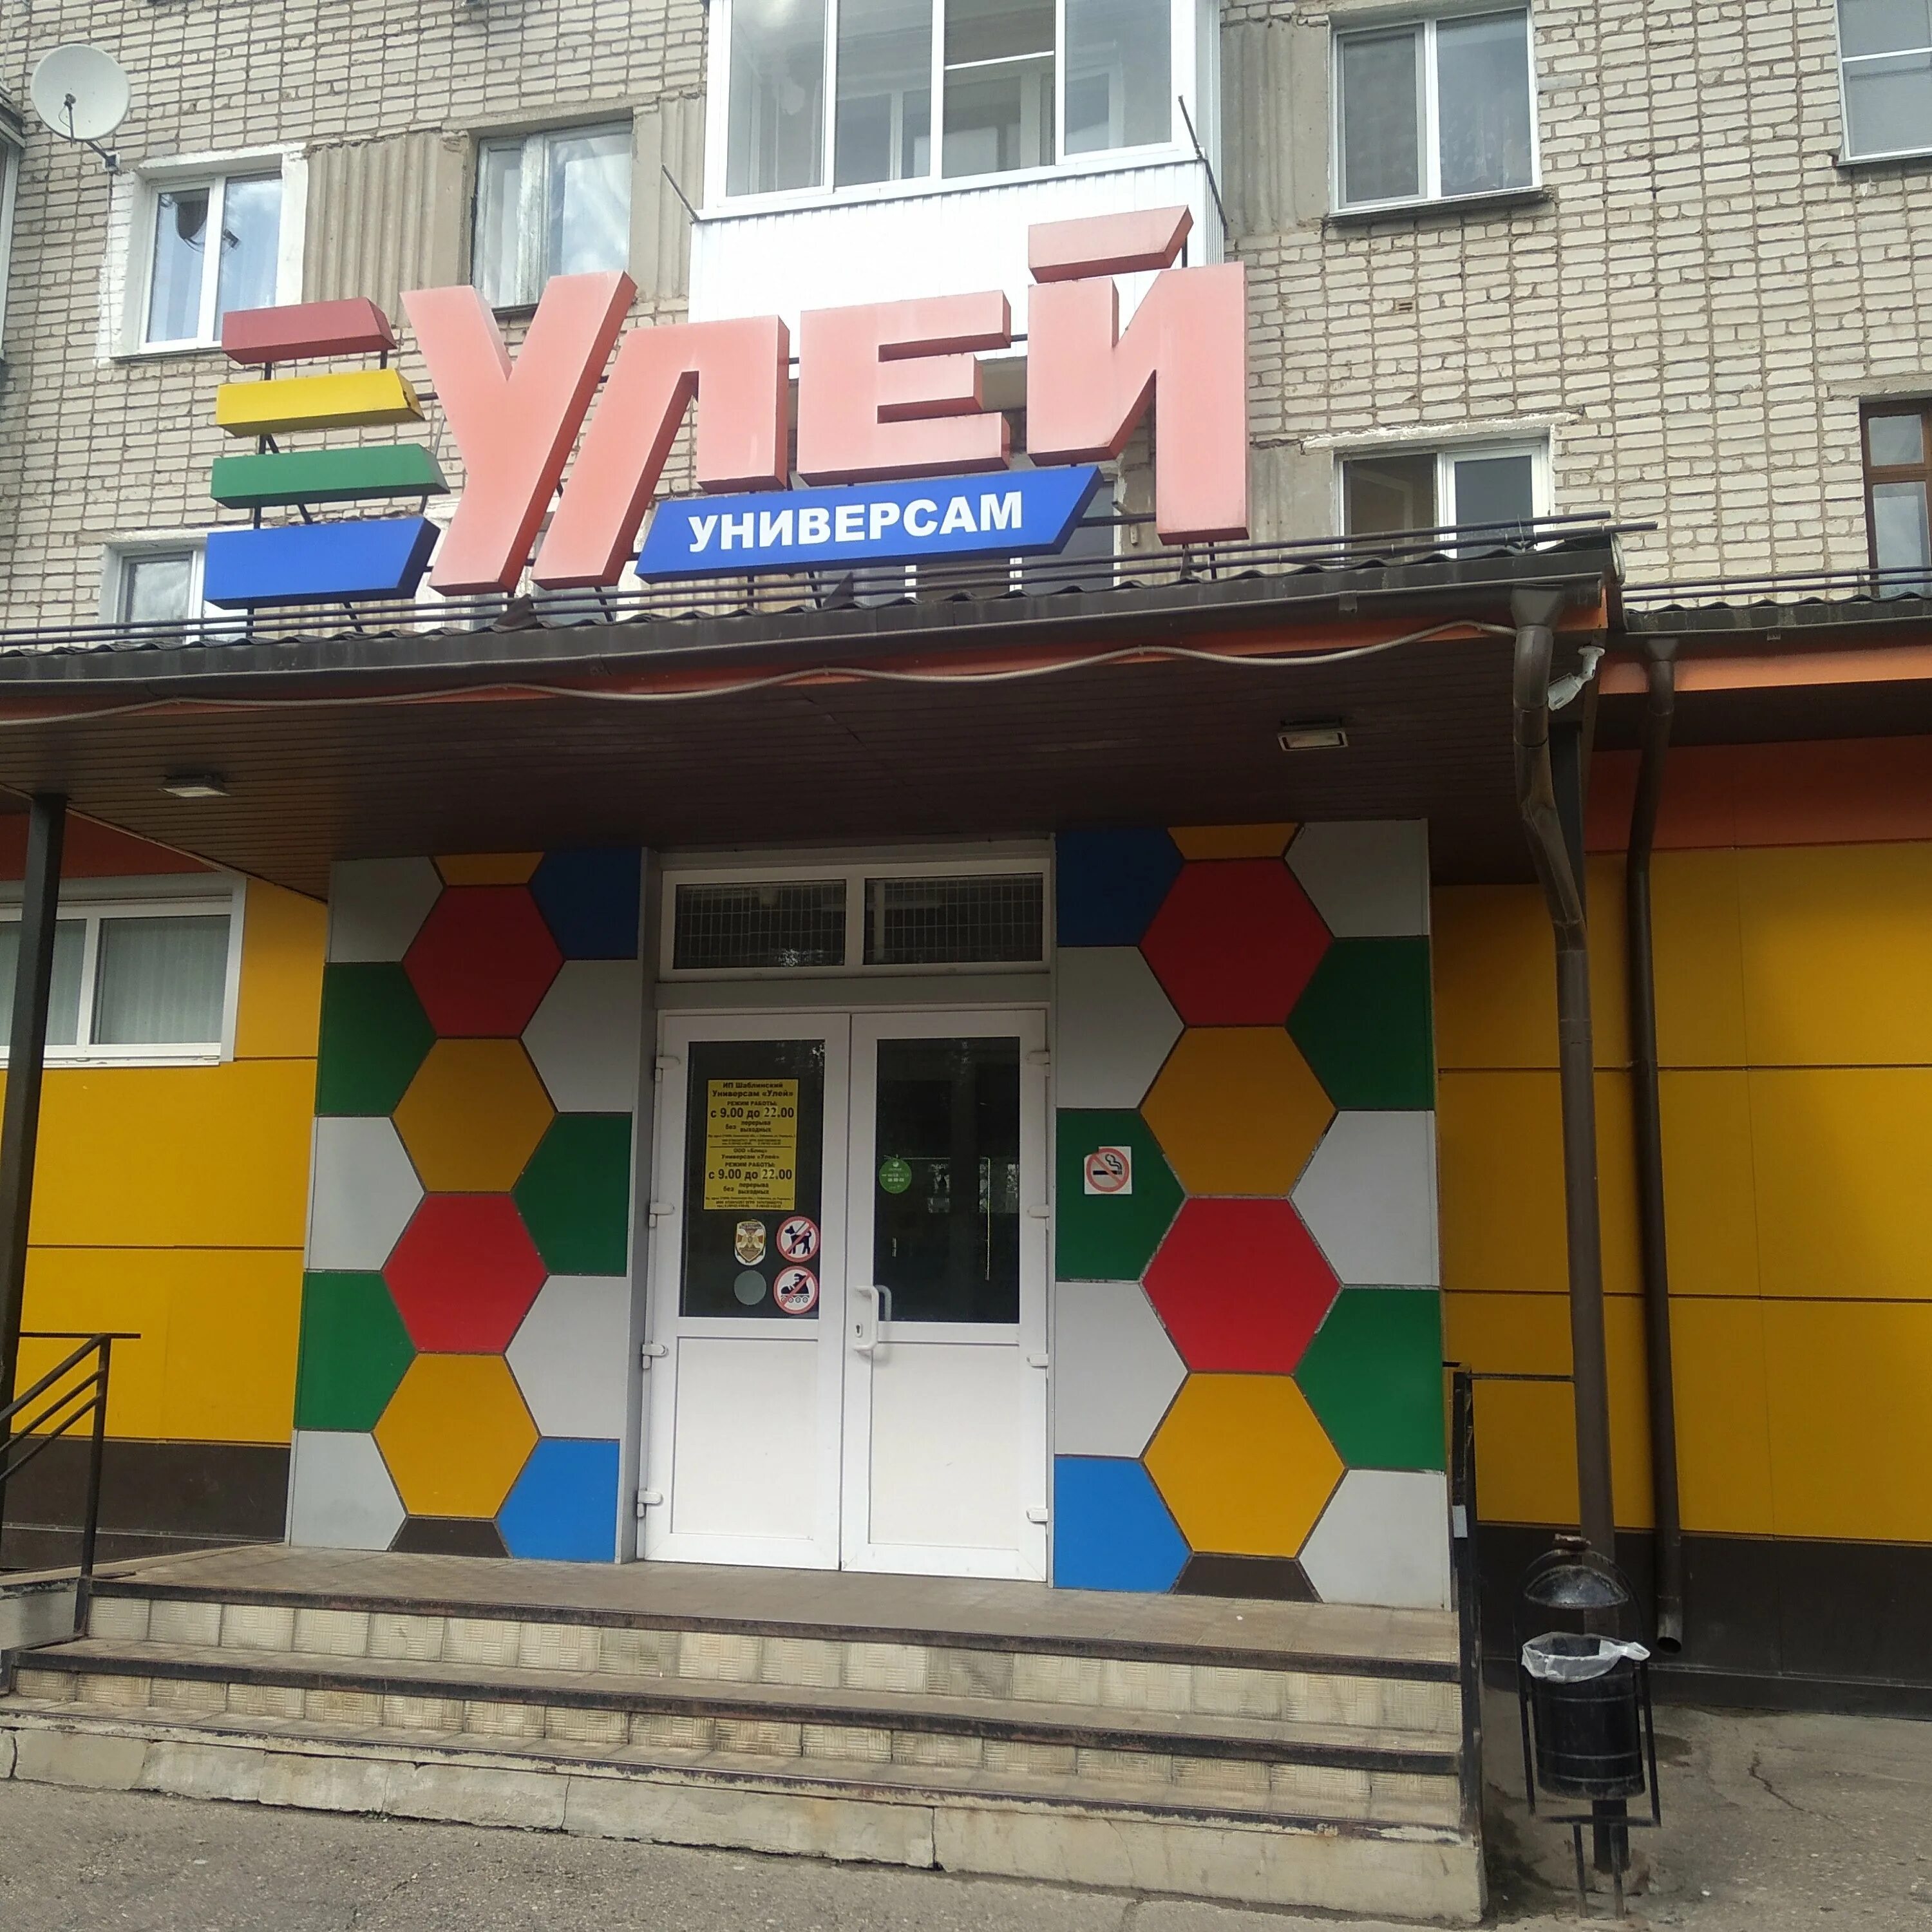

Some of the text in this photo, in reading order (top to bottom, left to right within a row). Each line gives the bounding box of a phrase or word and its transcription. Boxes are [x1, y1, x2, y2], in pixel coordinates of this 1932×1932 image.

[401, 205, 1248, 597] УЛЕЙ
[688, 491, 1023, 553] УНИВЕРСАМ
[712, 1090, 759, 1098] Универсам
[710, 1107, 794, 1119] с 9.00 до 22.00
[718, 1169, 741, 1179] 9.00
[744, 1171, 759, 1181] до
[762, 1169, 792, 1180] 22.00
